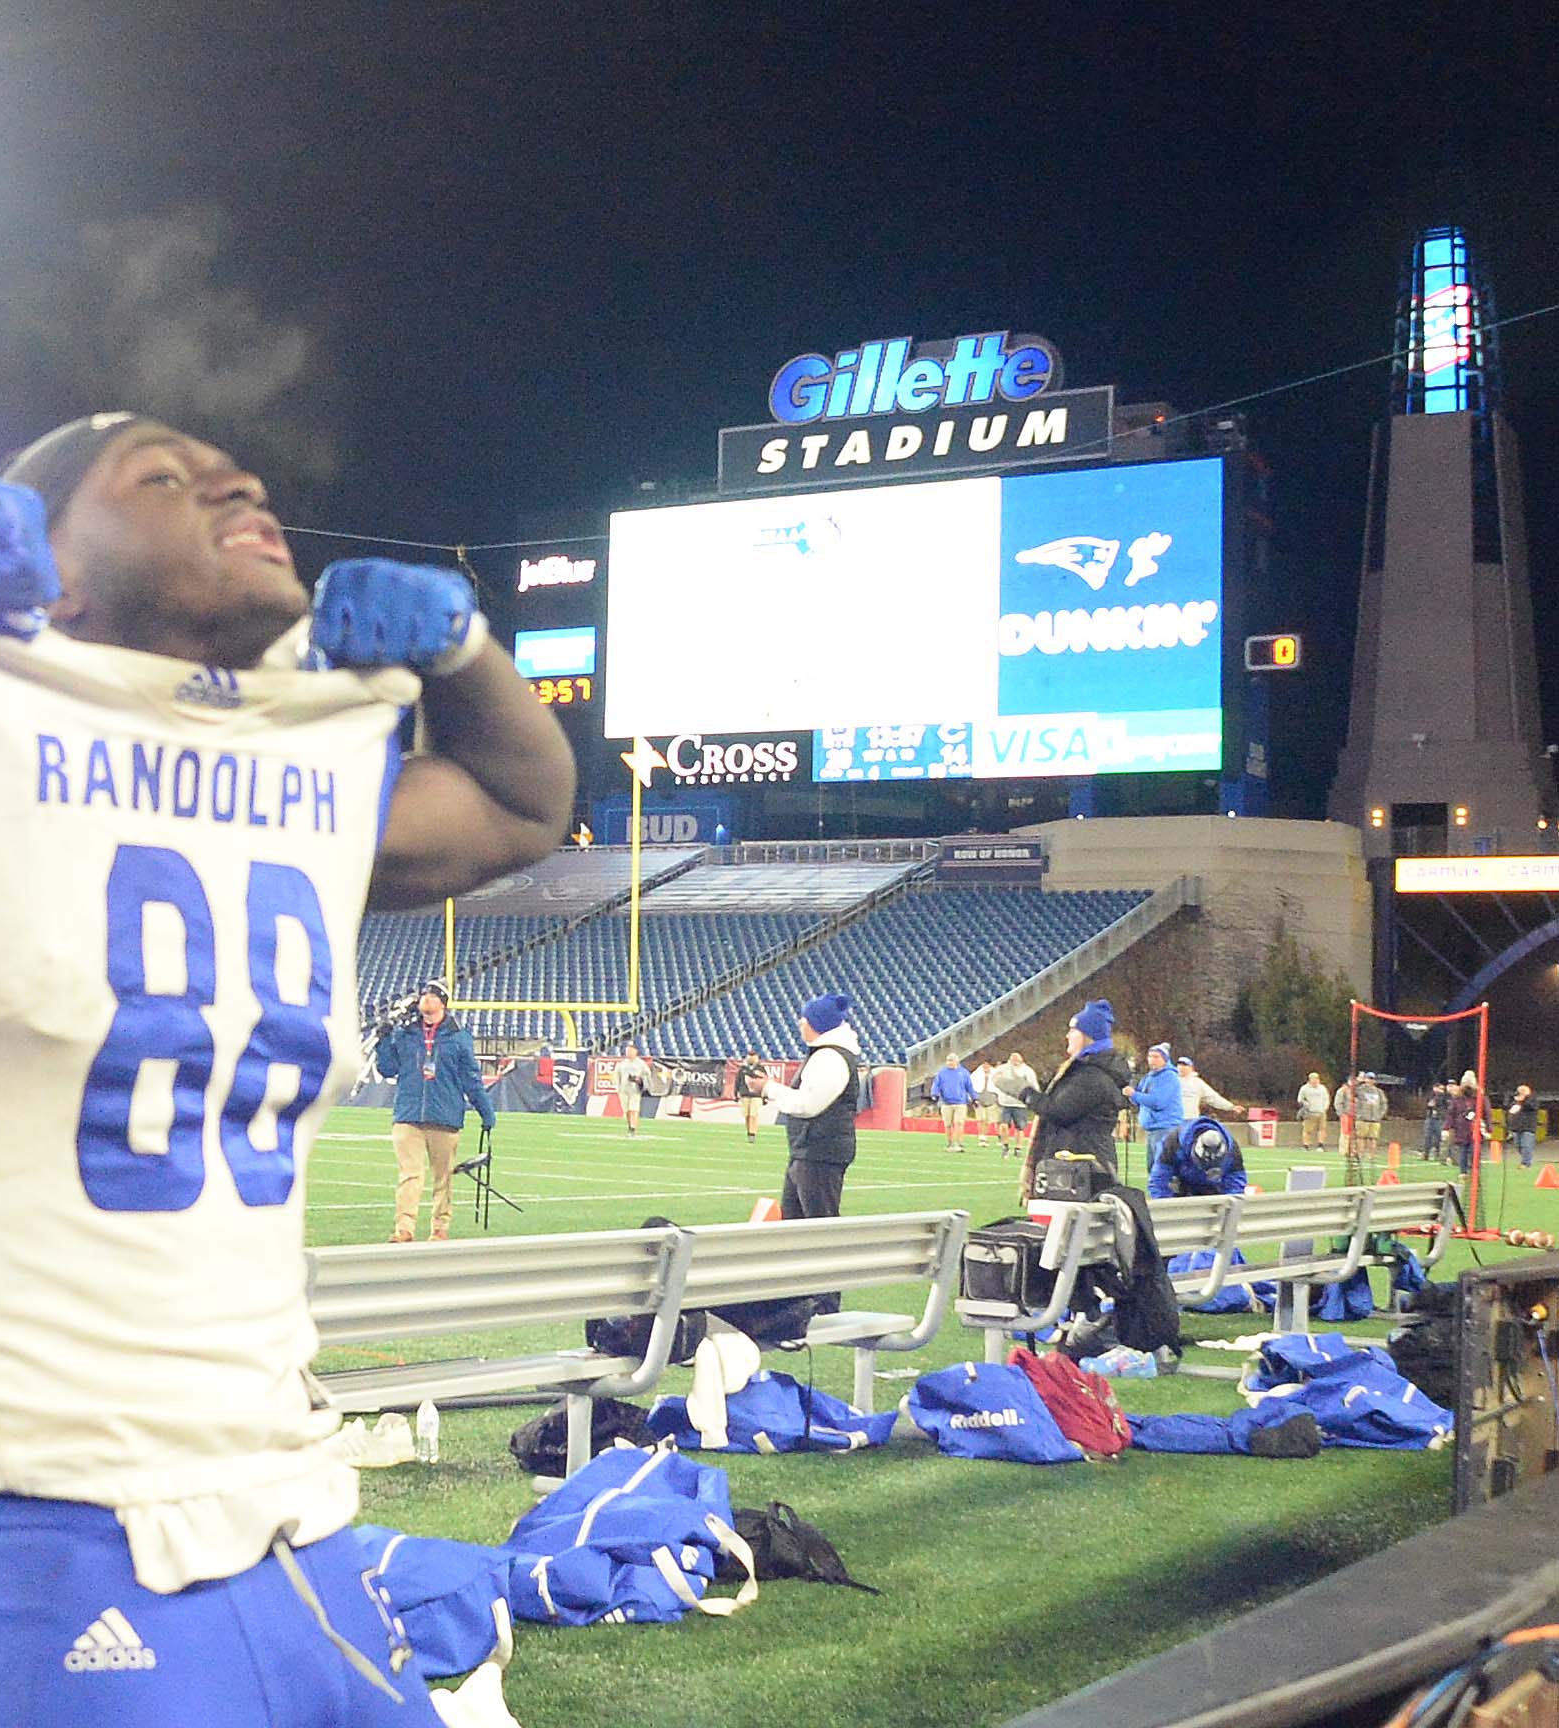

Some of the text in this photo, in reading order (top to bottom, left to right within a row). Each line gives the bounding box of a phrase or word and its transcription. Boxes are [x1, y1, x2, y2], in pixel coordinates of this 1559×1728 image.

[770, 331, 1053, 424] Gillette
[756, 408, 1068, 474] STADIUM
[989, 727, 1090, 764] VISA
[36, 732, 338, 835] RANDOLPH
[626, 814, 699, 846] BUD
[76, 842, 333, 1213] 88
[63, 1645, 158, 1673] adidas
